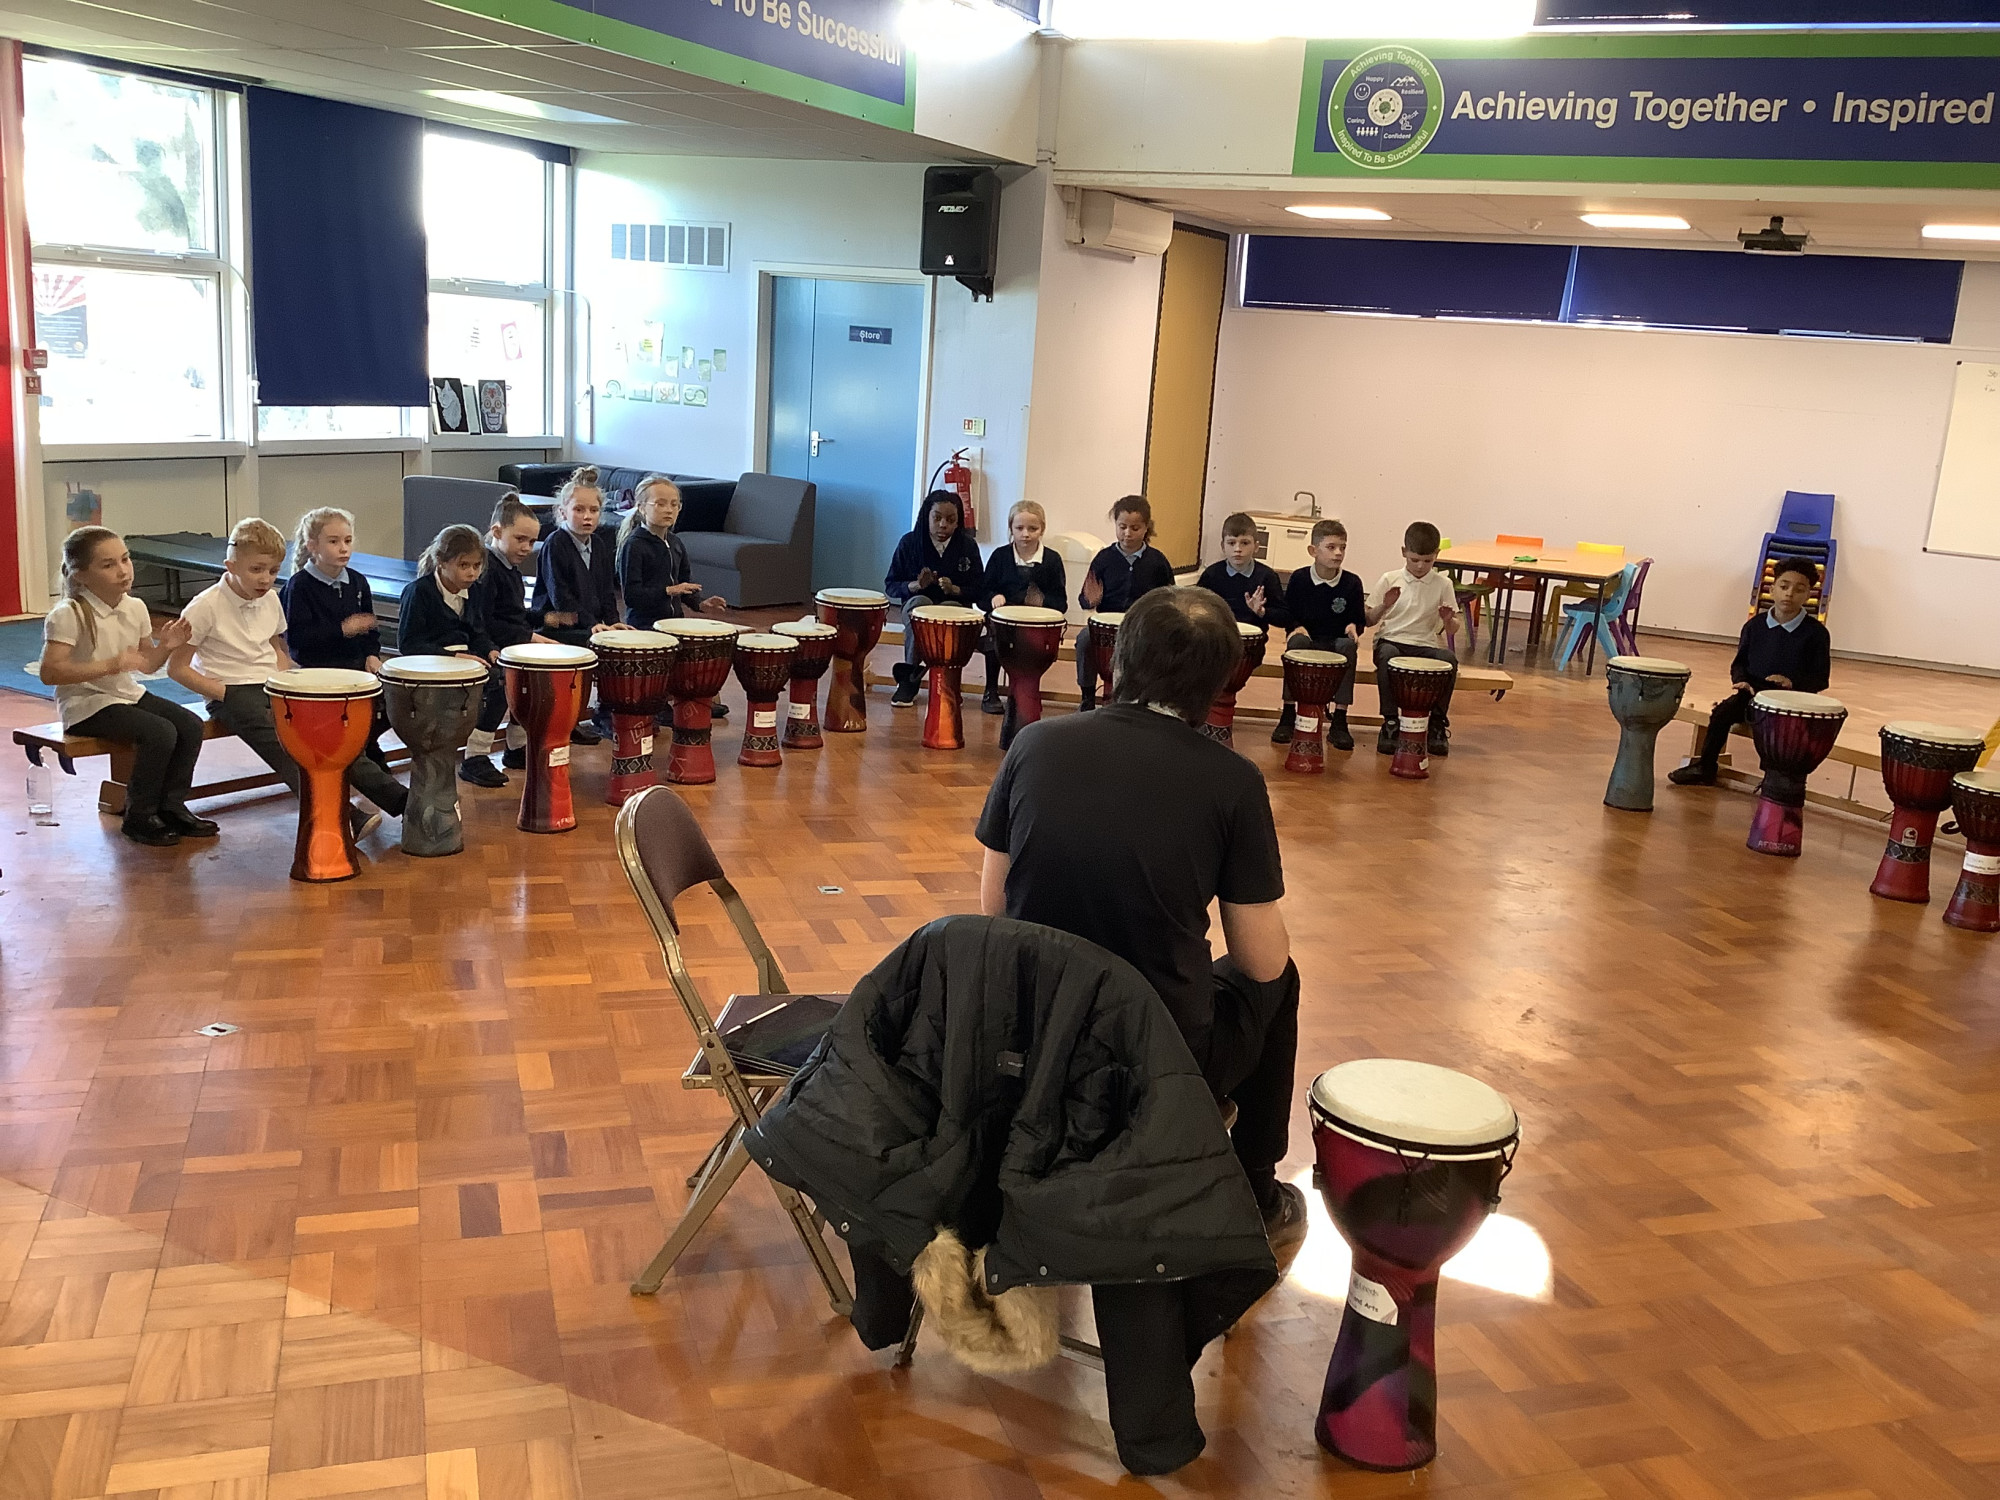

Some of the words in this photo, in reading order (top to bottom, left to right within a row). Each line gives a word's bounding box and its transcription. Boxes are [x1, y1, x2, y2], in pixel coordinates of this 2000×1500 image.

[762, 0, 791, 29] Be
[797, 1, 900, 66] Successful
[1350, 51, 1394, 78] Achieving
[1396, 50, 1430, 77] Together
[1451, 91, 1618, 129] Achieving
[1629, 91, 1788, 130] Together
[1832, 91, 1995, 132] Inspired
[1337, 129, 1364, 158] Inspired
[1363, 152, 1373, 163] To
[1374, 154, 1386, 164] Be
[1387, 129, 1429, 163] Successful
[859, 330, 881, 340] Store
[1364, 1302, 1379, 1312] Arts
